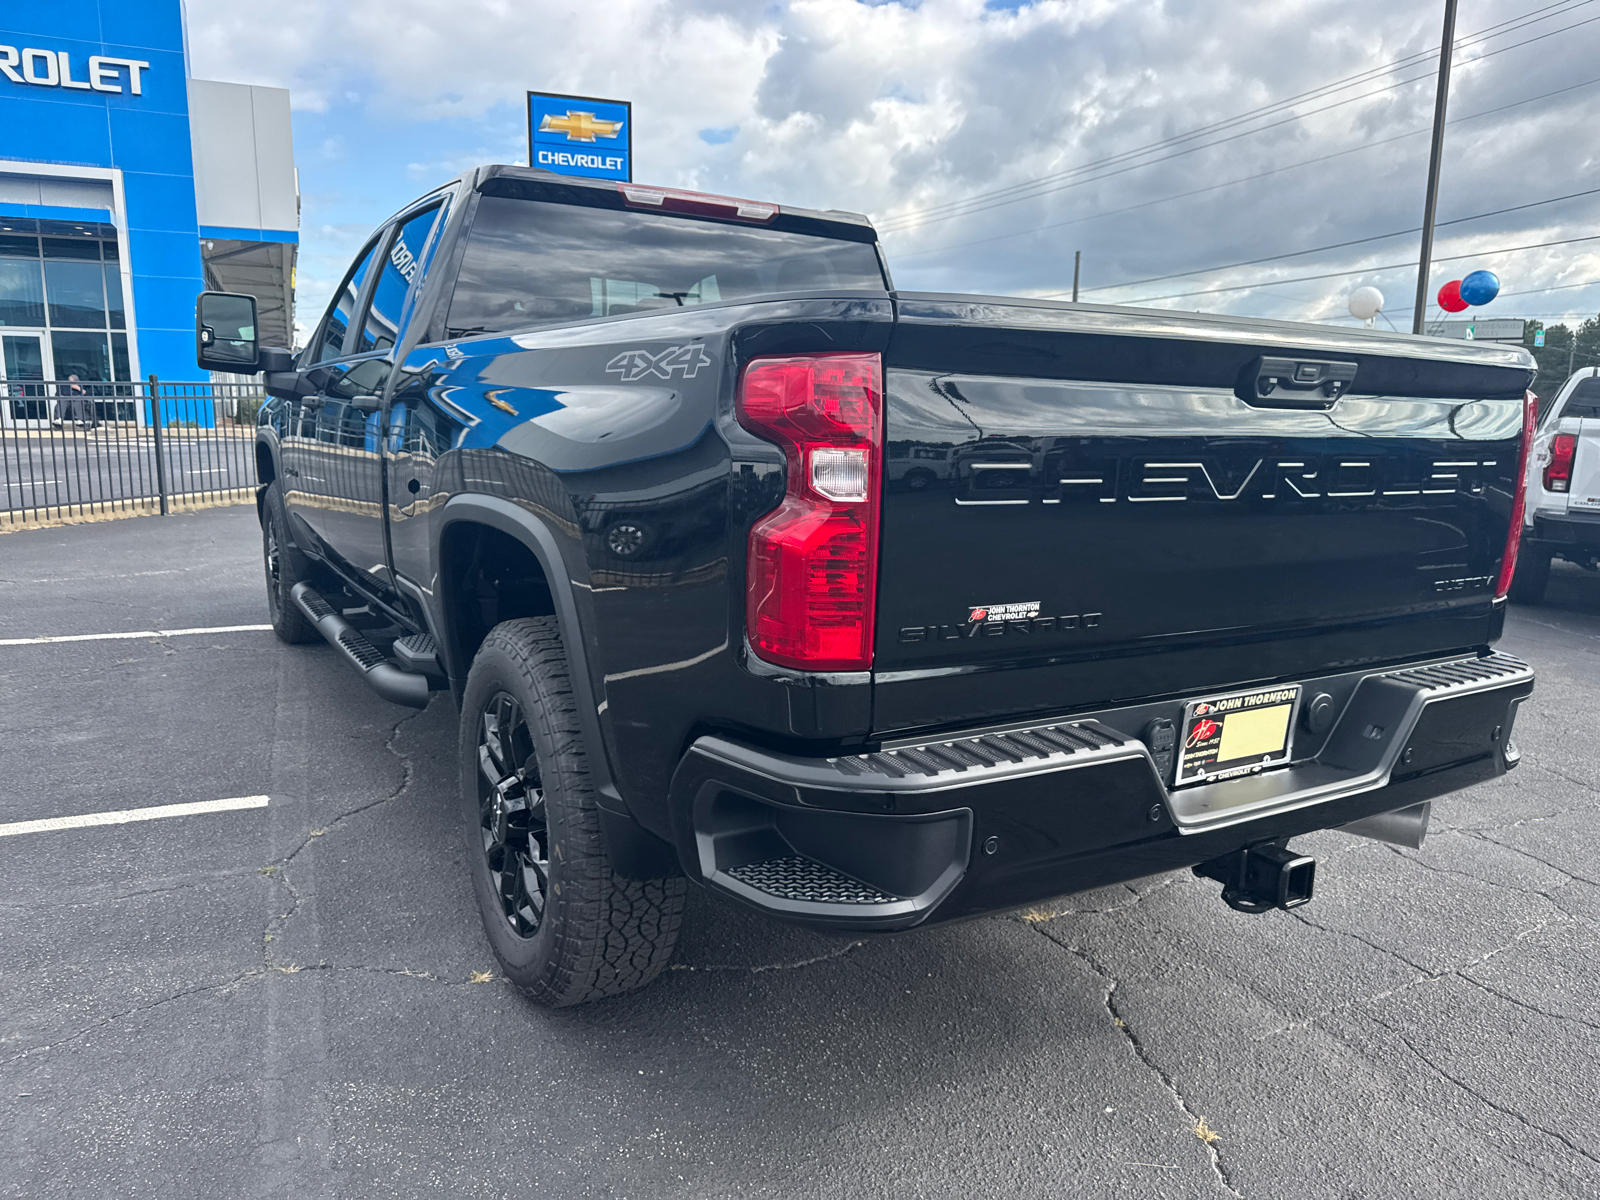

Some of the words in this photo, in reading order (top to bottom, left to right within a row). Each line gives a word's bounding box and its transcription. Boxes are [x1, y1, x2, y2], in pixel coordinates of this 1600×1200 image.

[538, 150, 624, 171] CHEVROLET
[953, 455, 1499, 505] CHEVROLET
[987, 611, 1027, 621] CHEVROLET
[988, 605, 1006, 614] JOHN
[1006, 603, 1040, 612] THORNTON
[898, 612, 1102, 643] SILVERADO
[1213, 698, 1242, 712] JOHN
[1244, 689, 1297, 708] THORNTON
[1218, 767, 1251, 779] CHEVROLET
